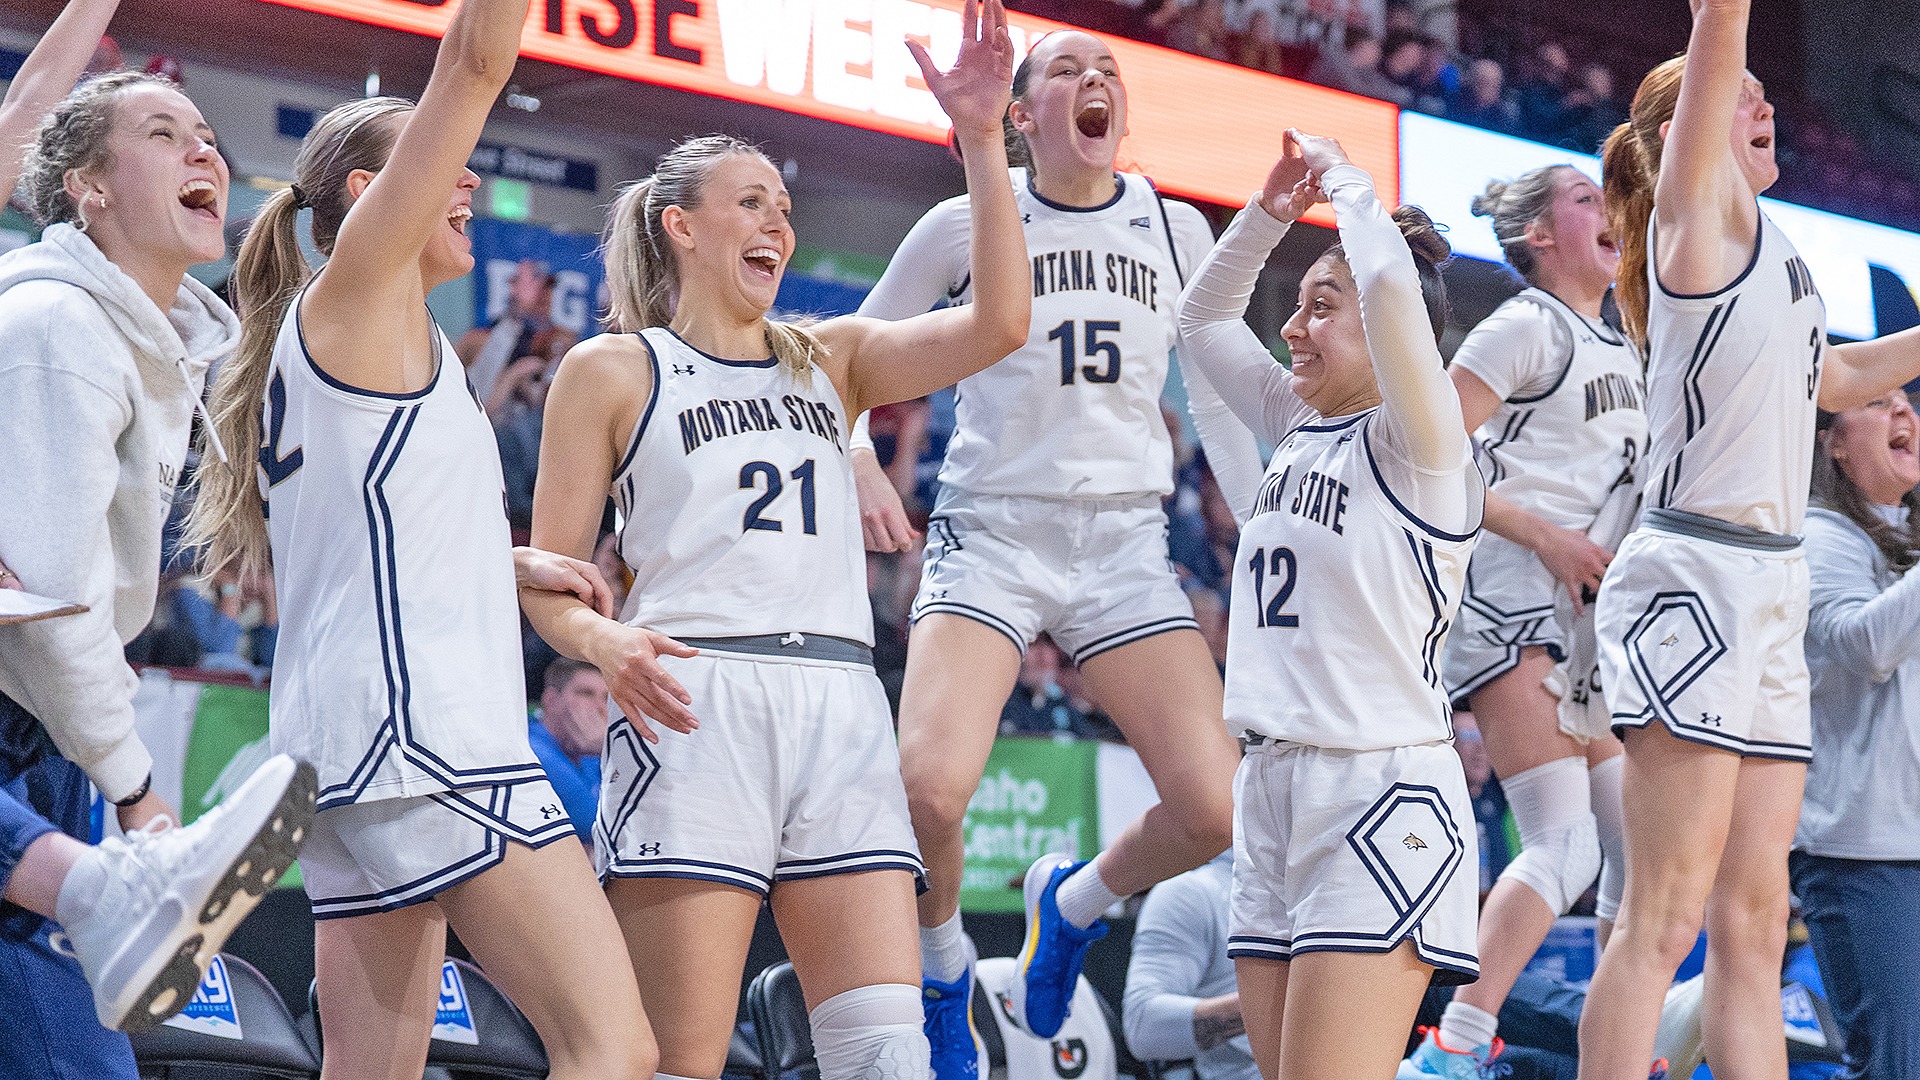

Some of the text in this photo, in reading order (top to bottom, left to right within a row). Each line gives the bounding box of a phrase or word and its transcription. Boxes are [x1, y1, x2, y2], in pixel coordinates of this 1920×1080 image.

[1033, 250, 1158, 313] NTANA STATE
[1048, 319, 1121, 386] 15
[678, 394, 844, 456] MONTANA STATE
[738, 458, 818, 537] 21
[1291, 471, 1350, 537] STATE
[1249, 546, 1300, 629] 12
[967, 768, 1048, 815] aho
